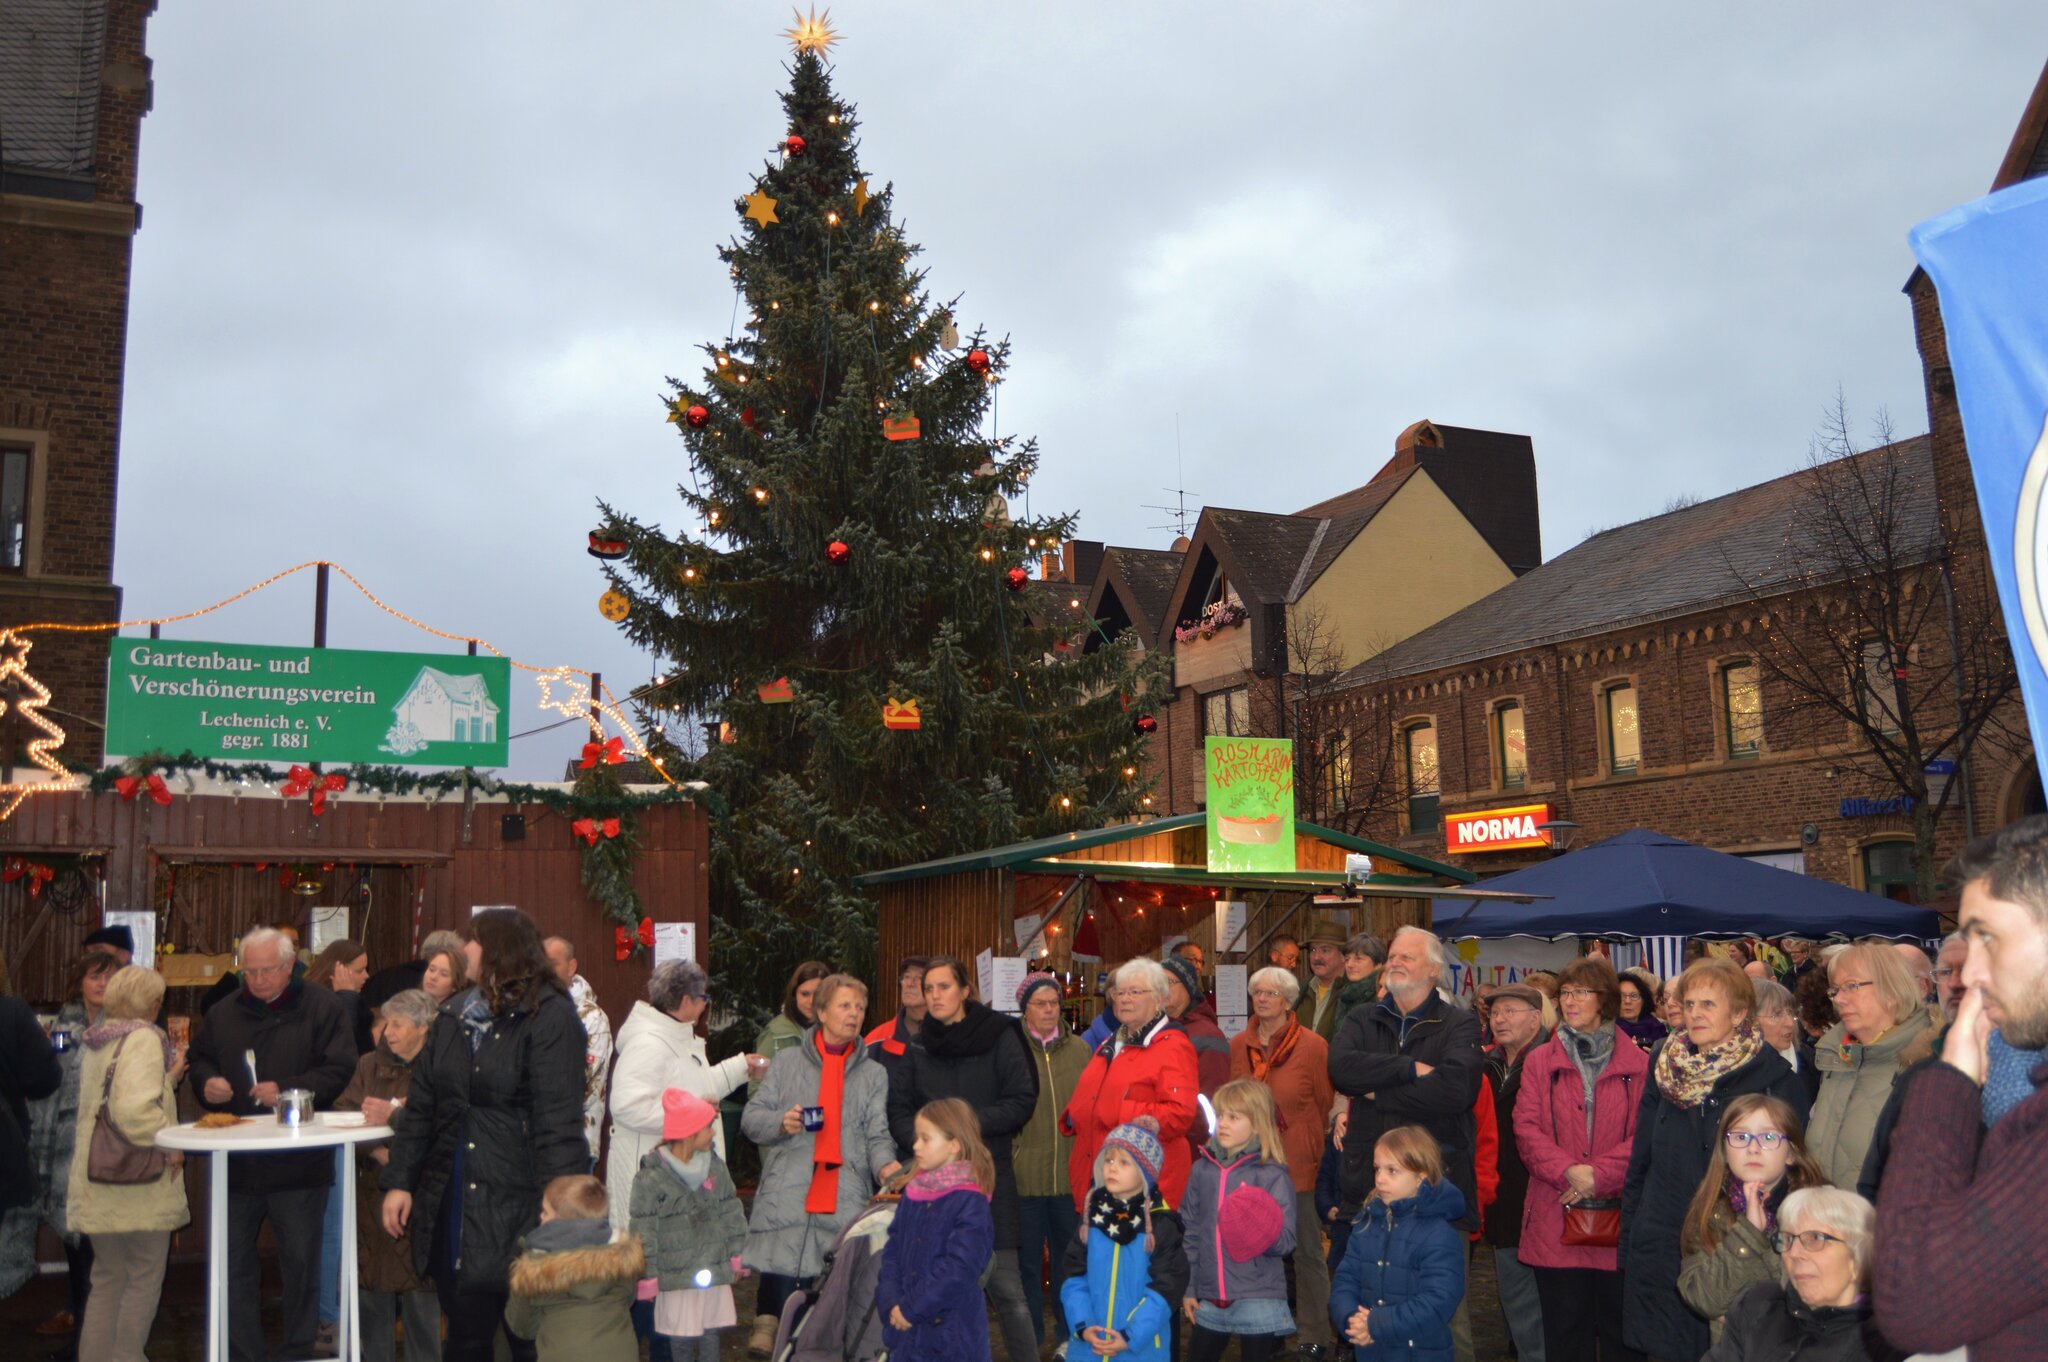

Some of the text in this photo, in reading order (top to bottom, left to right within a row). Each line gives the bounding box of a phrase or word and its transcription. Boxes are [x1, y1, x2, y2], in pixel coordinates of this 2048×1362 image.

[130, 646, 311, 675] Gartenbau- und
[129, 674, 376, 705] Verschönerungsverein
[200, 711, 332, 731] Lechenich e. V.
[222, 732, 309, 750] gegr. 1881
[1212, 741, 1293, 772] ROSMARIN
[1458, 816, 1537, 843] NORMA
